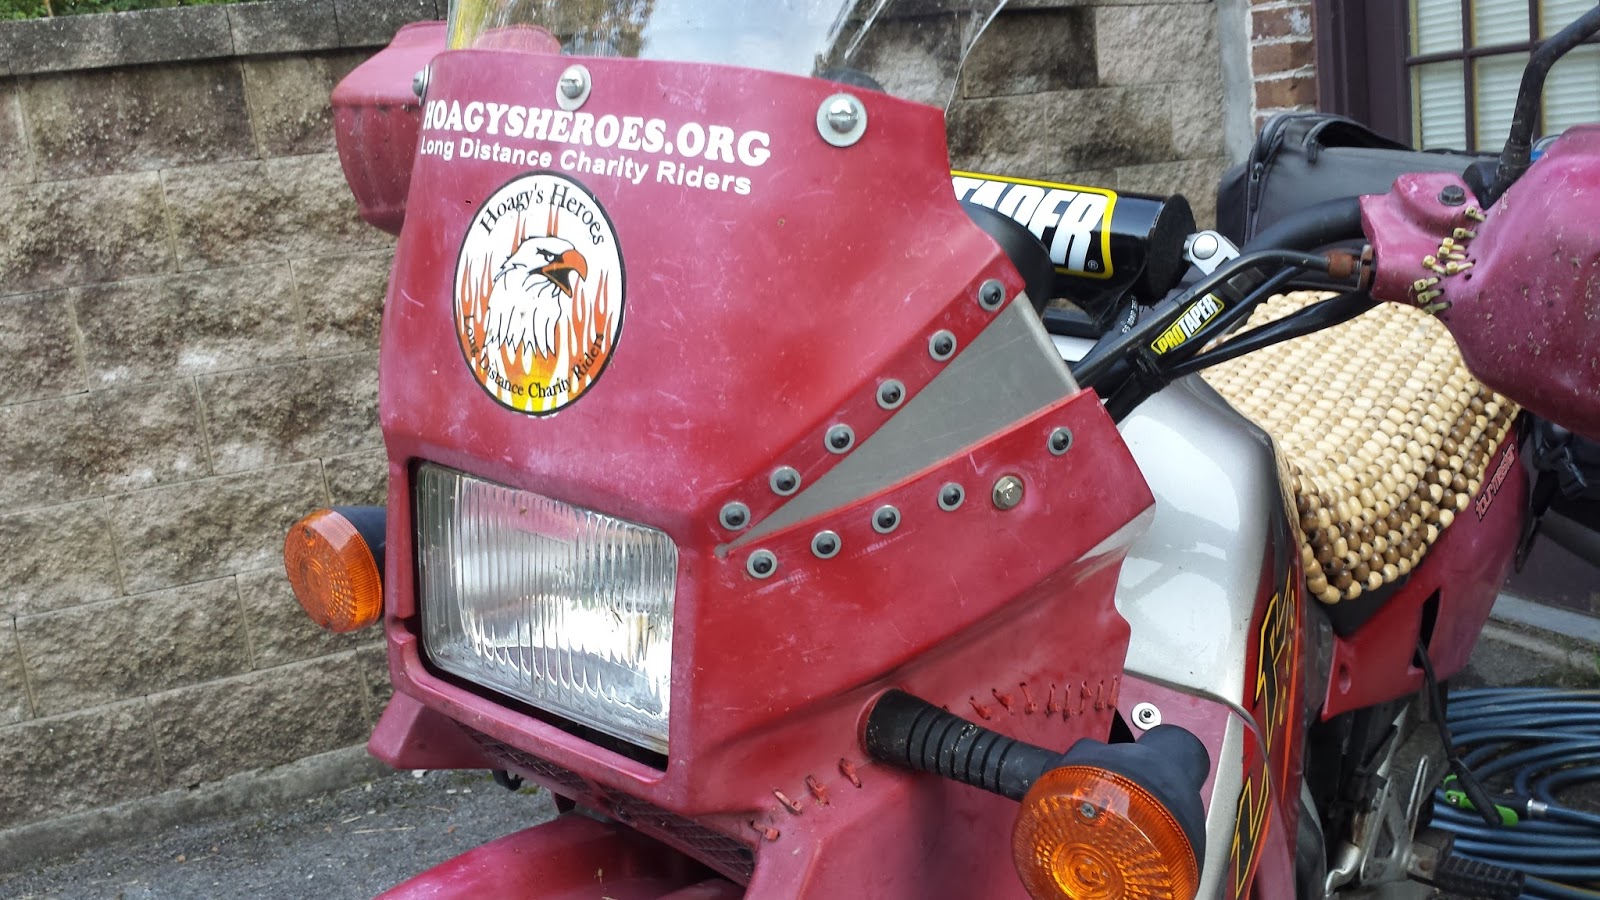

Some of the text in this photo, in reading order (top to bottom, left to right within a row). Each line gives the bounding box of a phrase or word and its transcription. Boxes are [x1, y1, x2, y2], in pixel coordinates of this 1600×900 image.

[423, 99, 771, 167] HOAGYSHEROES.ORG
[420, 136, 751, 195] Long Distance Charity Riders
[479, 182, 605, 246] Hoagy's Heroes
[1157, 293, 1219, 353] PROTAPER
[463, 315, 604, 398] Long Distance Charity Riders
